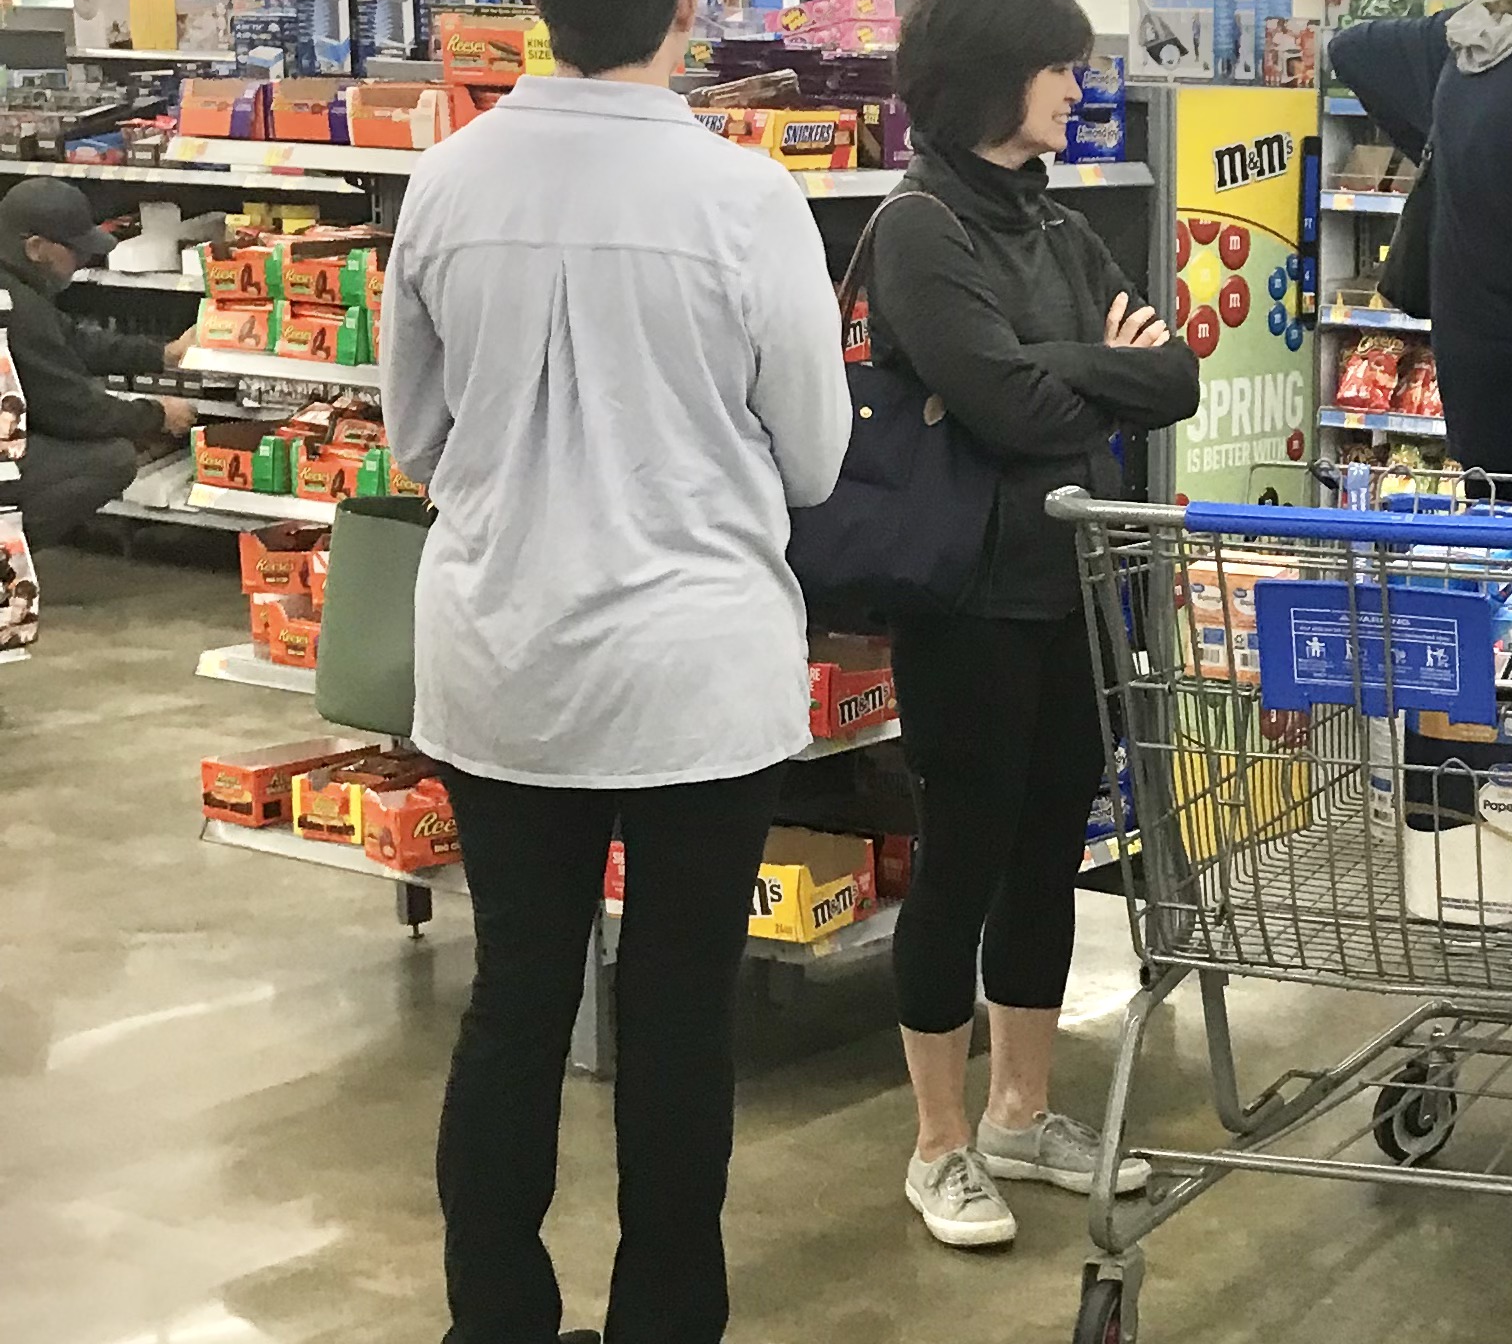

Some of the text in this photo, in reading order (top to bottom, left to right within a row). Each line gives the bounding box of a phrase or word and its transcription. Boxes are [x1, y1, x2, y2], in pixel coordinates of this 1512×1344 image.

[527, 39, 551, 48] KING
[528, 49, 552, 60] SIZE
[784, 123, 834, 145] SNICKERS
[1186, 370, 1304, 443] SPRING
[1187, 436, 1287, 474] IS BETTER WITH
[414, 812, 458, 840] Ree
